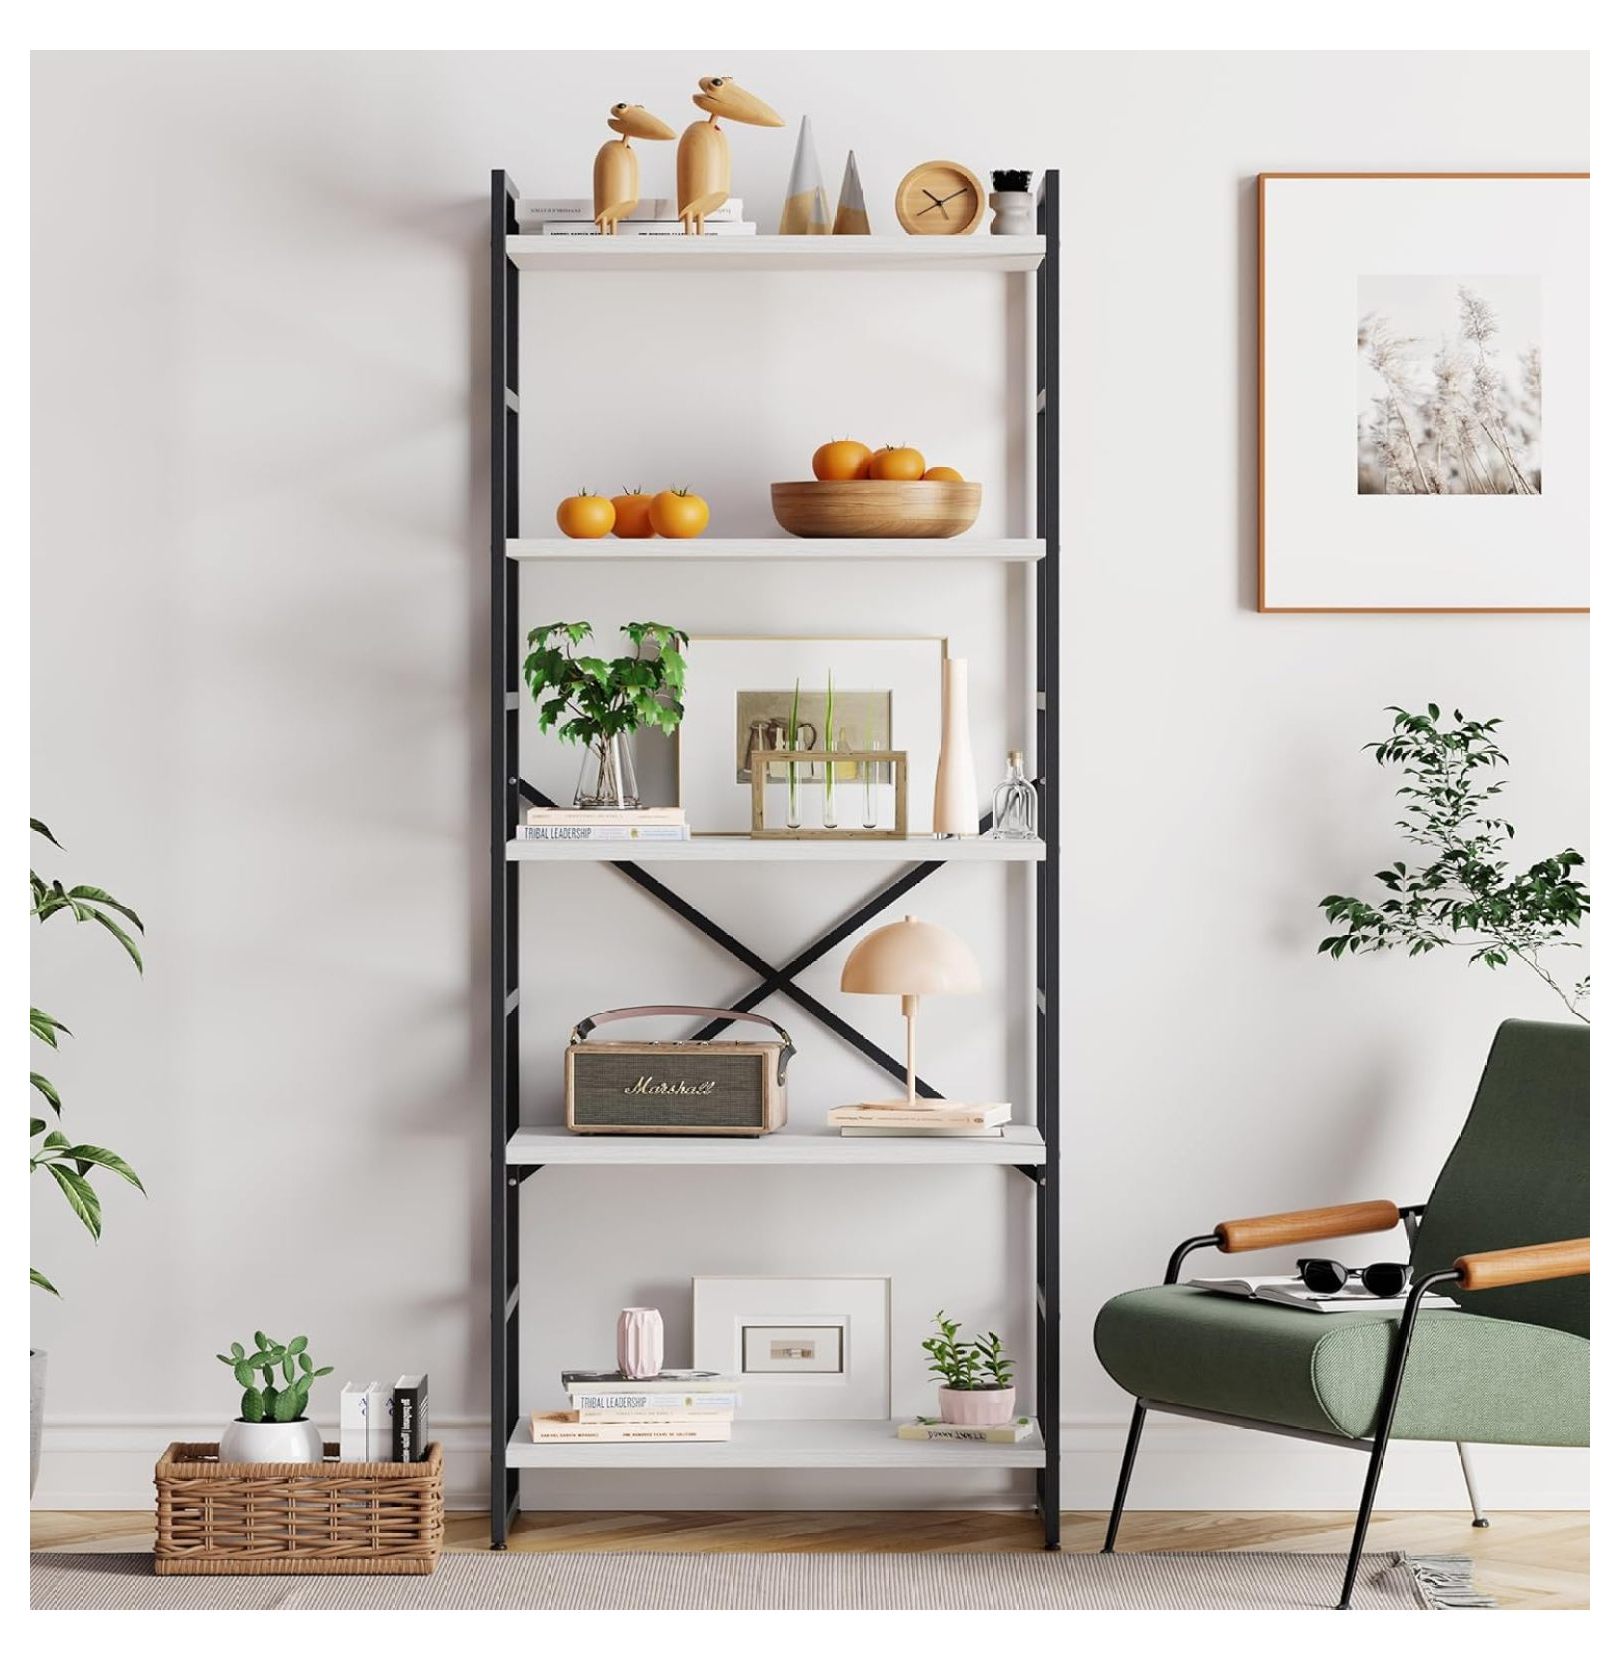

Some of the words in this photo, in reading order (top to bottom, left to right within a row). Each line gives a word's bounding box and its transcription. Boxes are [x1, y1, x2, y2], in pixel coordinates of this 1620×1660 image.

[525, 827, 549, 839] TRIBAL
[550, 827, 592, 839] LEADERSHIP
[624, 1076, 716, 1095] Marshall
[581, 1396, 605, 1408] TRIBAL
[606, 1396, 647, 1408] LEADERSHIP
